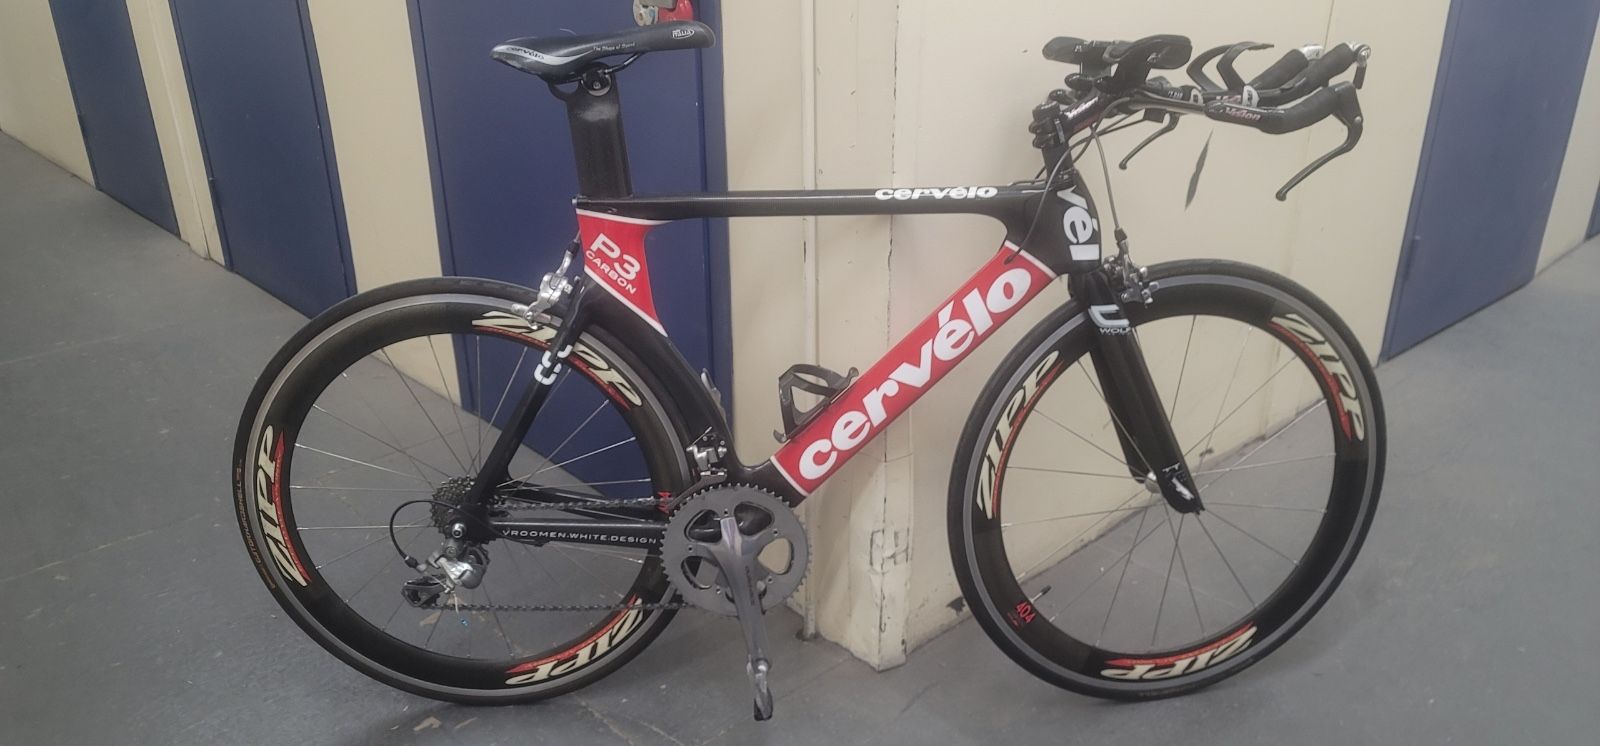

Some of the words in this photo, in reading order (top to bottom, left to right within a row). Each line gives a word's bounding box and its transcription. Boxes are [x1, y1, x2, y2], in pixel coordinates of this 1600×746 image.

[585, 250, 638, 294] CARBON
[590, 232, 641, 281] P3
[799, 267, 1032, 481] cervélo
[1271, 313, 1365, 441] ZIPP
[977, 350, 1060, 519] ZIPP
[257, 425, 308, 587] ZIPP
[505, 597, 643, 685] ZIPP
[1016, 601, 1036, 624] 404
[1100, 626, 1258, 680] ZIPP
